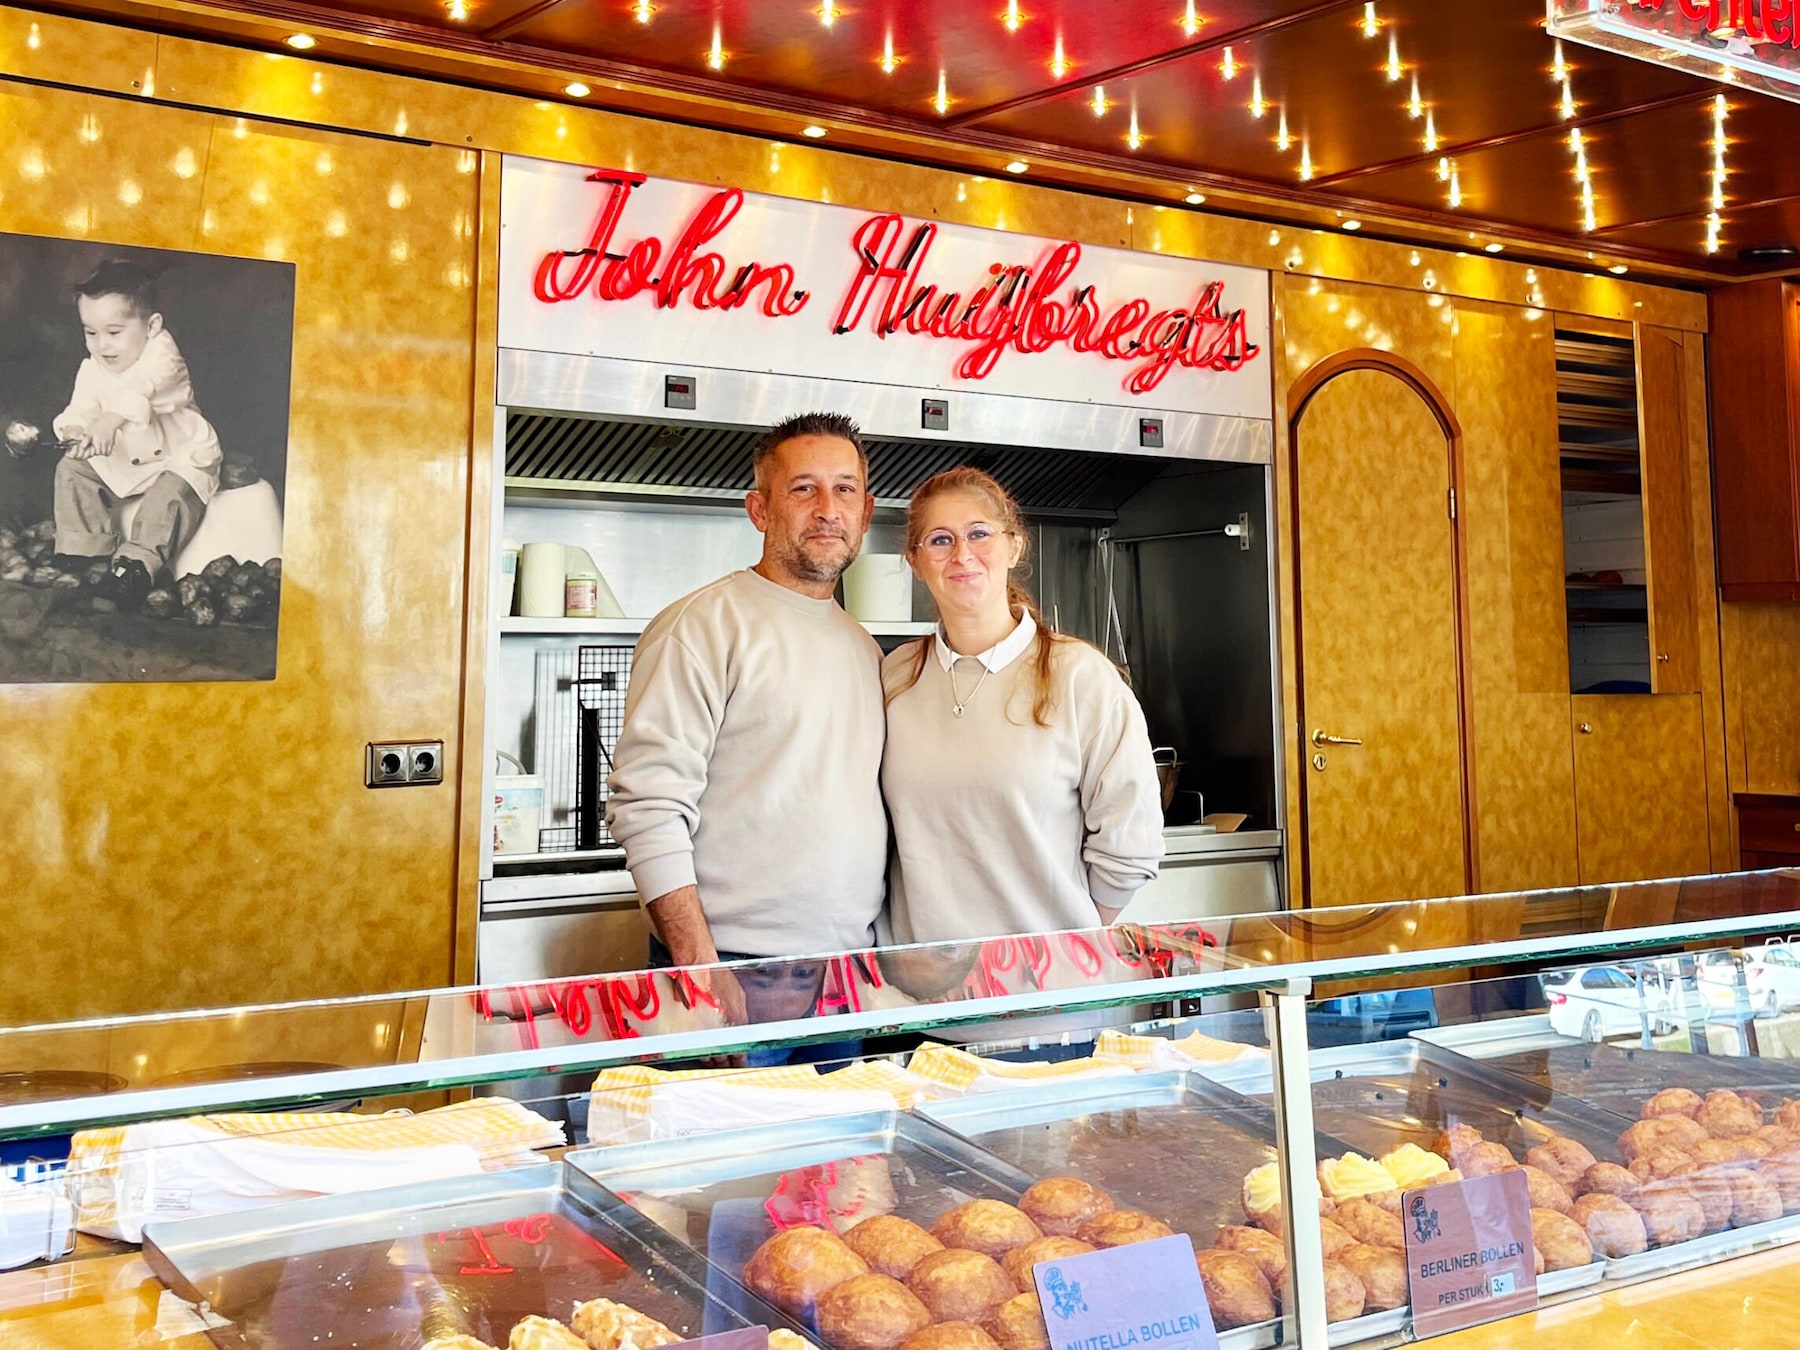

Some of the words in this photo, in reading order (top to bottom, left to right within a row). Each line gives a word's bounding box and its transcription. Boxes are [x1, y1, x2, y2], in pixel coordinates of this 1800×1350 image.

[534, 169, 811, 317] John
[832, 213, 1260, 395] Huijbregts
[1420, 1252, 1478, 1278] BERLINER
[1480, 1242, 1524, 1265] BOLLEN
[1438, 1291, 1457, 1305] PER
[1459, 1284, 1484, 1300] STUK
[1066, 1328, 1139, 1350] NUTELLA
[1140, 1313, 1200, 1342] BOLLEN
